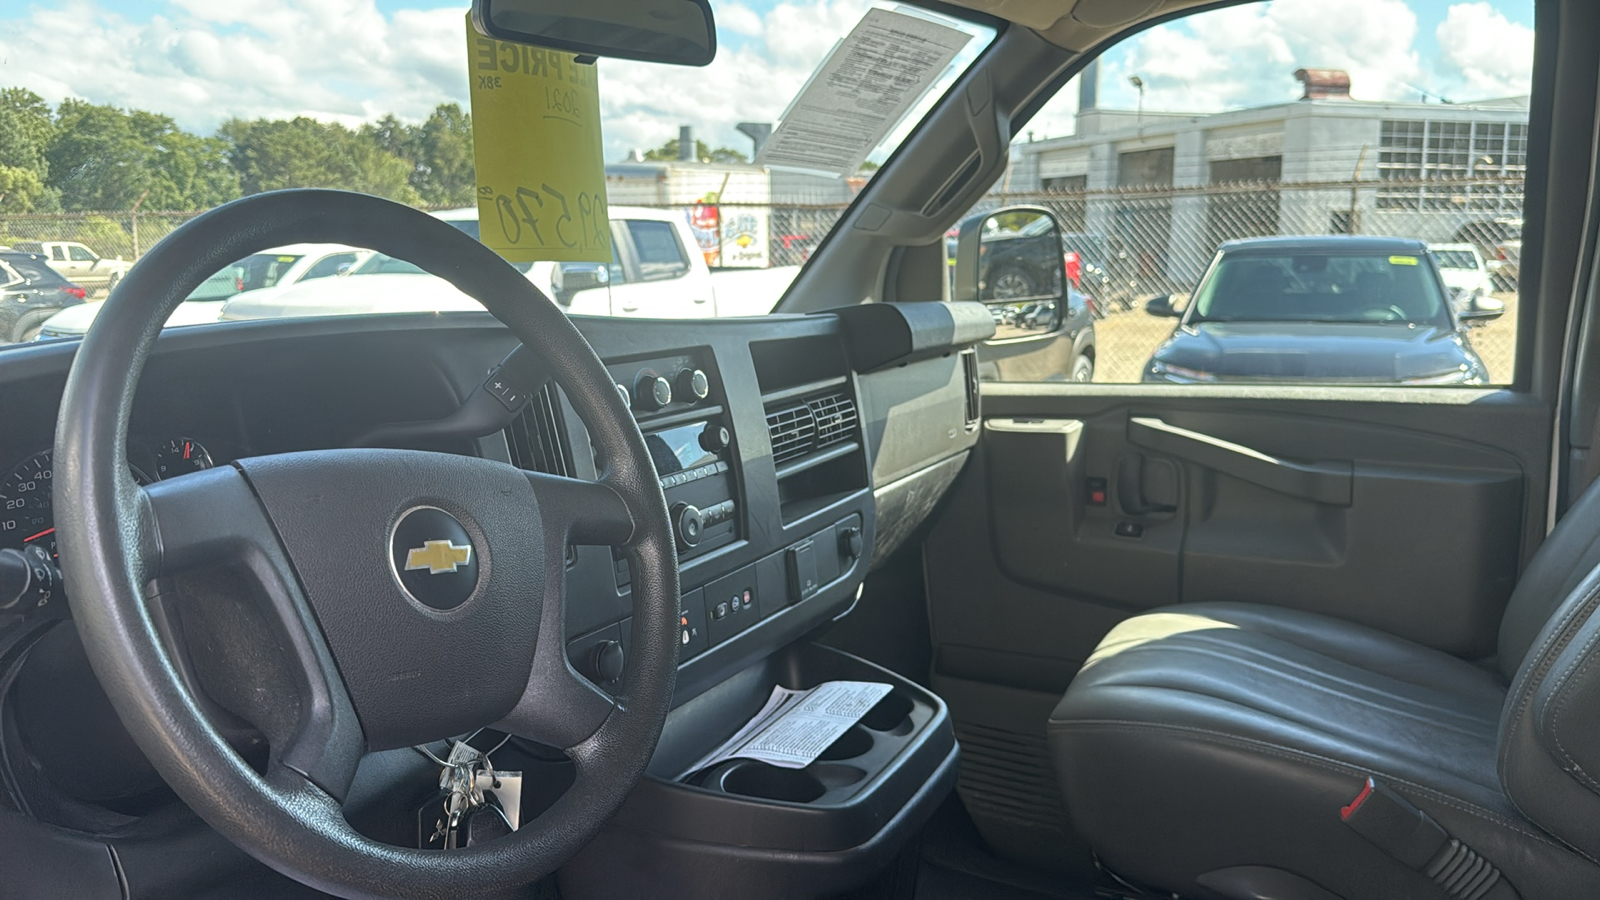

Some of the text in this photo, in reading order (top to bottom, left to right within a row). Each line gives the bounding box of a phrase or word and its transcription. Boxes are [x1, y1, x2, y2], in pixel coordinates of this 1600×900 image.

[34, 470, 52, 480] 40
[18, 481, 36, 492] 30
[6, 499, 25, 510] 20
[1, 520, 16, 531] 10
